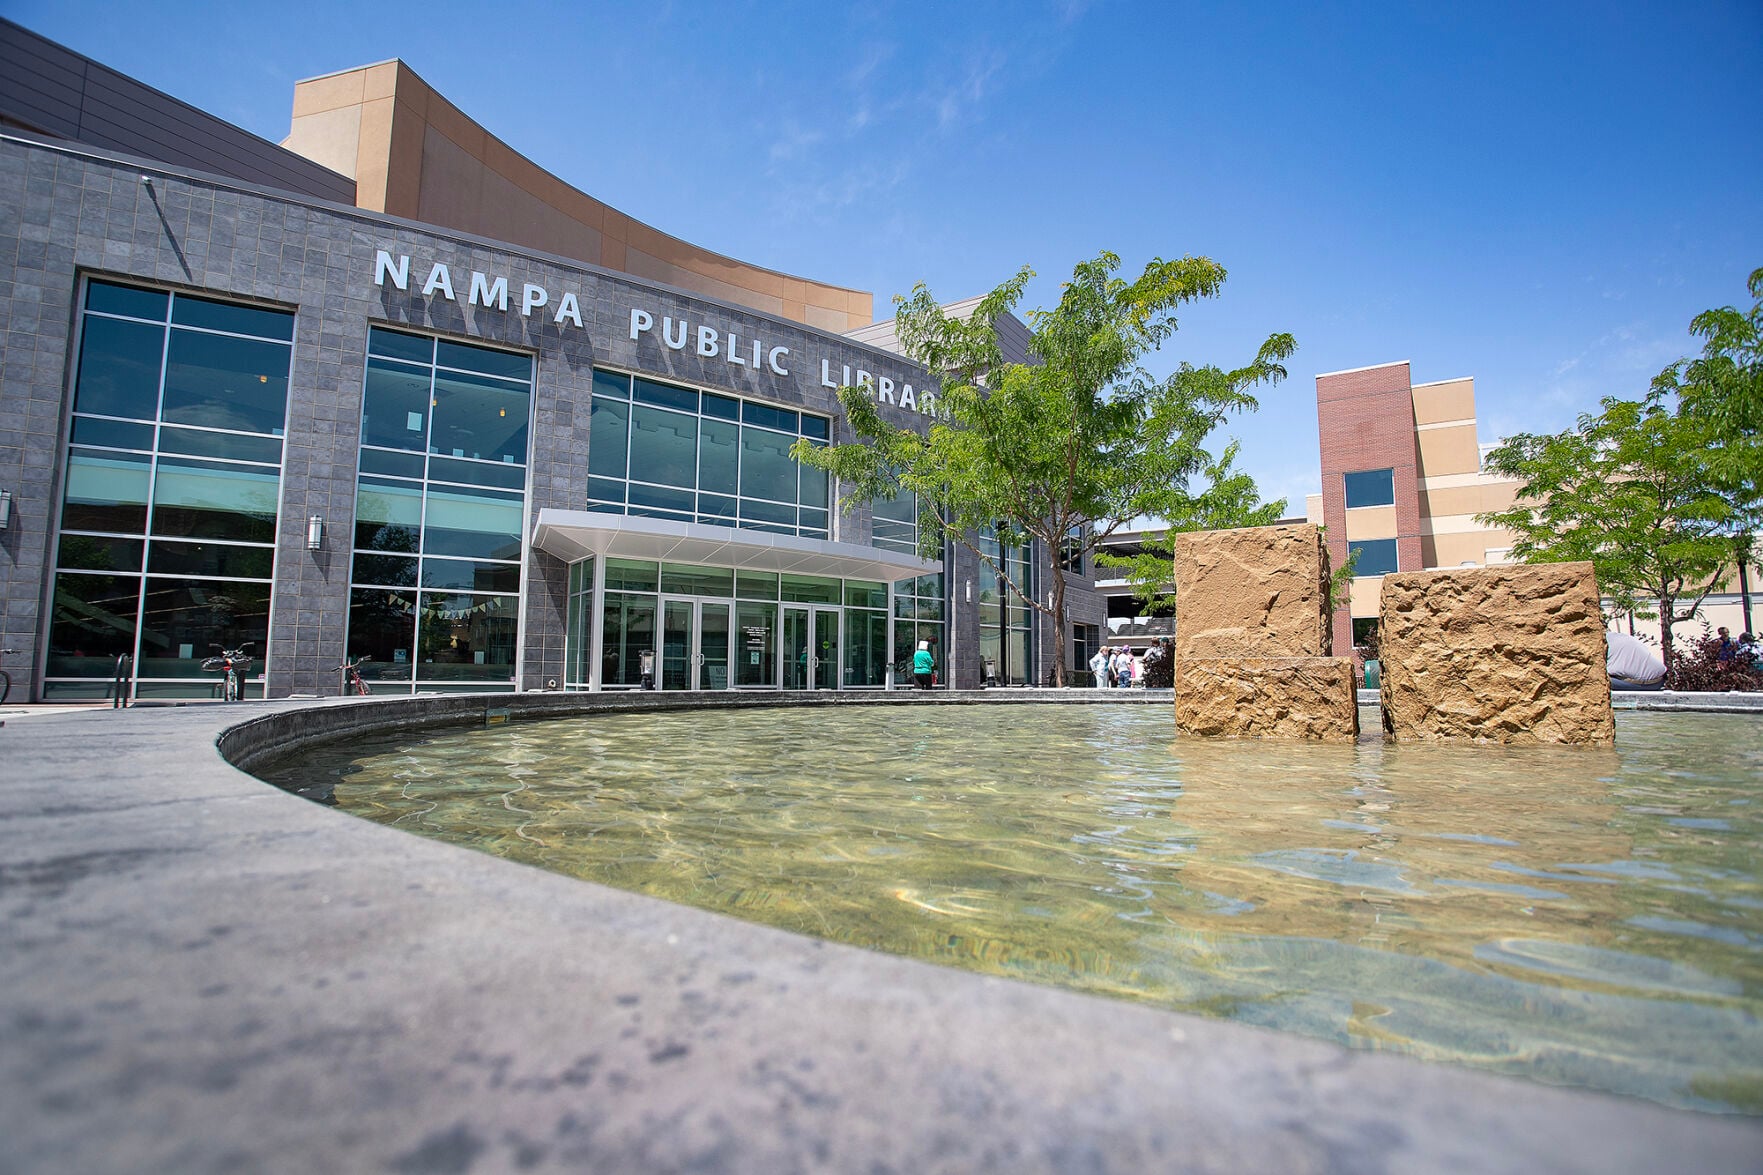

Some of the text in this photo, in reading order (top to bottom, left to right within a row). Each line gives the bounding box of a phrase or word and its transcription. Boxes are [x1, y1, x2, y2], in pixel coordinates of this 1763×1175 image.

[374, 250, 952, 419] NAMPA PUBLIC LIBRAR
